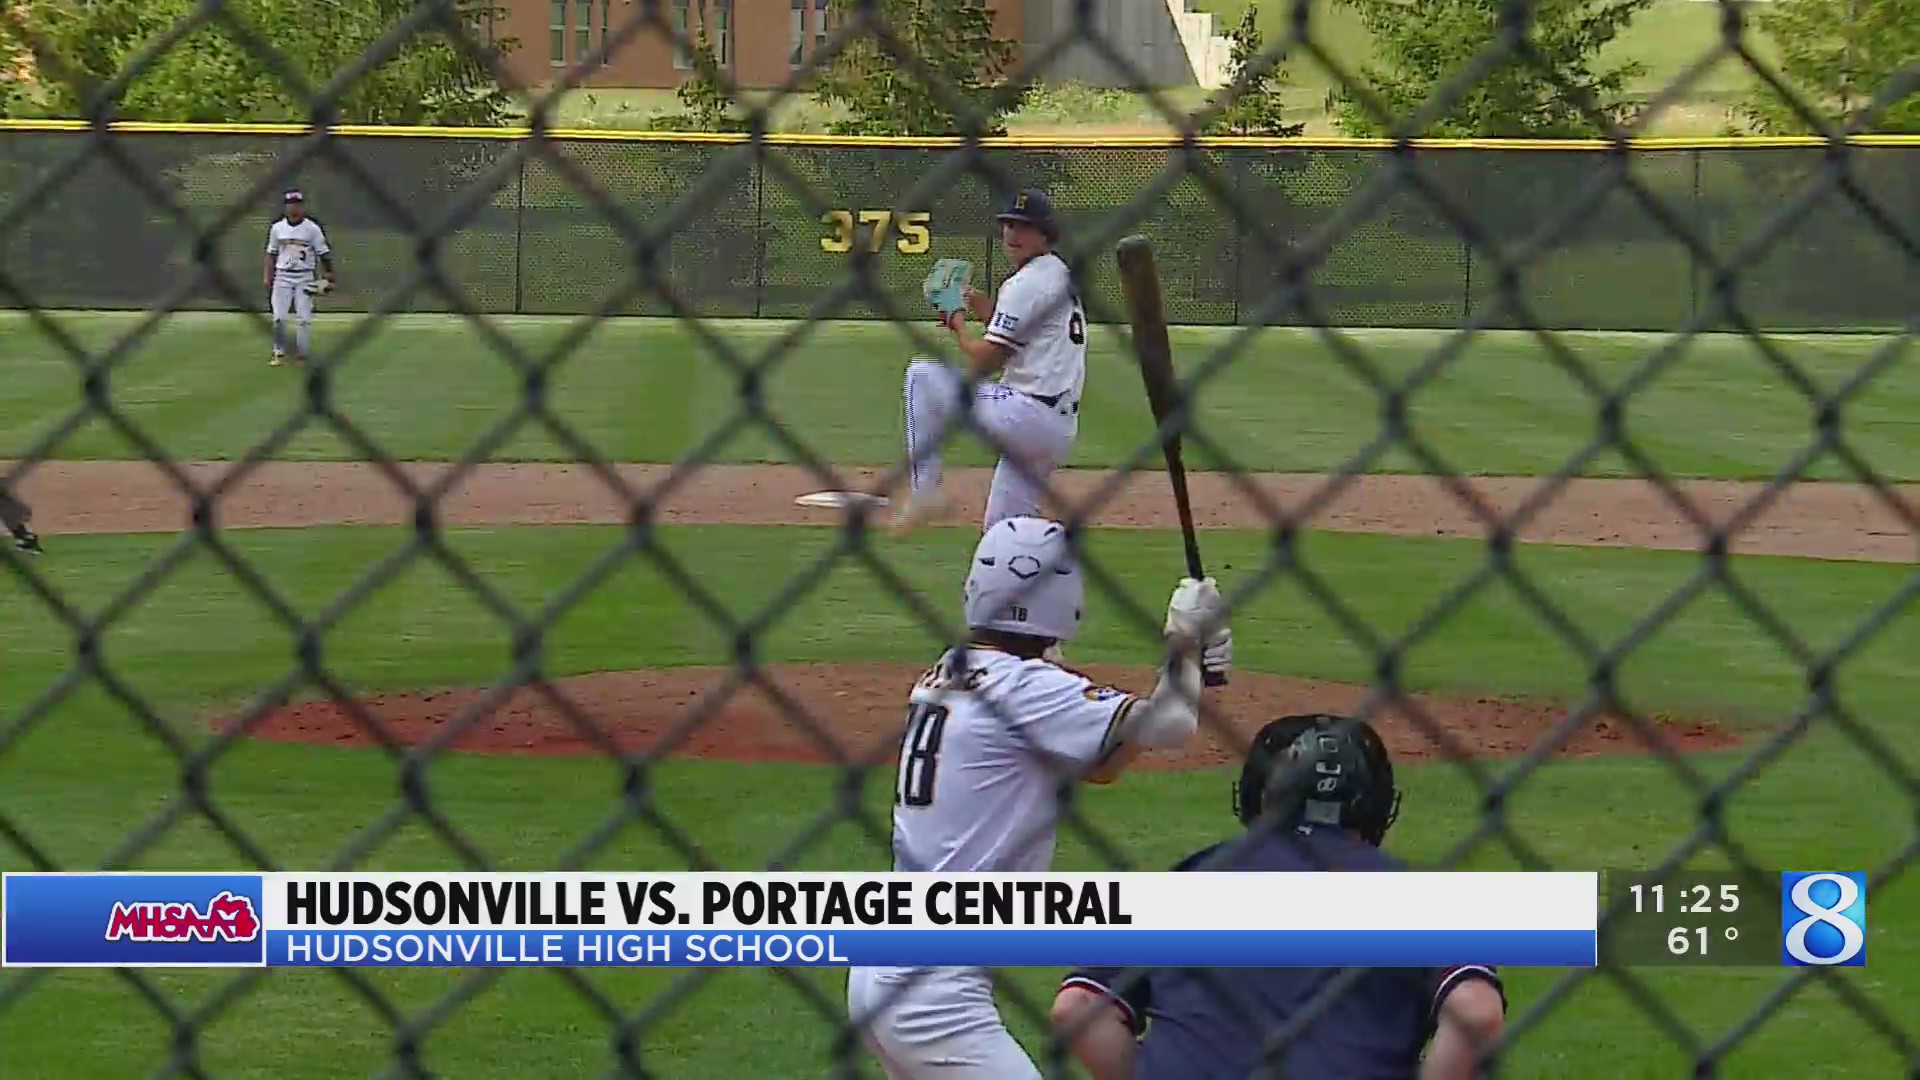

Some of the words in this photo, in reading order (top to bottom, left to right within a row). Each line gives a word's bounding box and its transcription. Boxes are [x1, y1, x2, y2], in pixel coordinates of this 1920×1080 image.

[820, 209, 931, 254] 375
[1012, 606, 1027, 621] 18
[895, 703, 949, 806] 18
